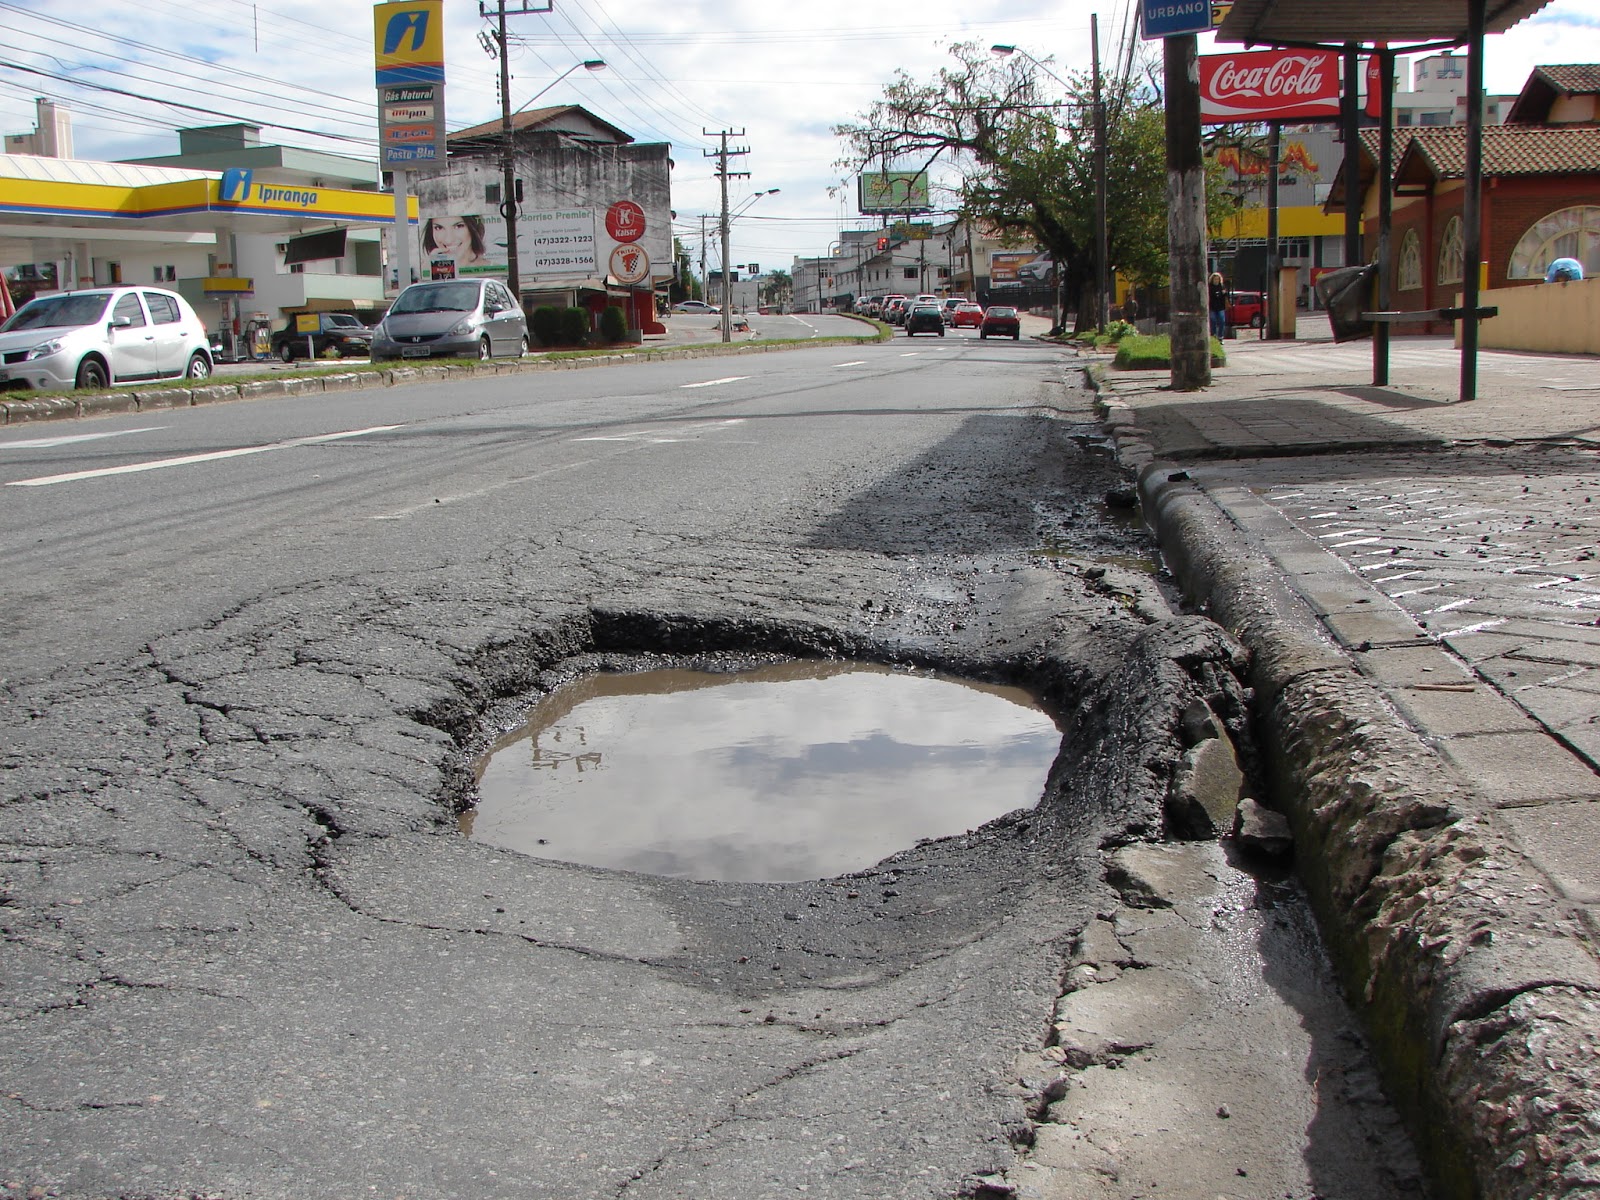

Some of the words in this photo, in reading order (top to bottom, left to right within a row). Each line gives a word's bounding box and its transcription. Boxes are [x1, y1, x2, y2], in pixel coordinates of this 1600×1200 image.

[1148, 2, 1204, 20] URBANO
[1209, 54, 1327, 100] Coca-Cola
[385, 92, 399, 102] Gás
[401, 89, 433, 100] Natural
[259, 184, 318, 207] Ipiranga
[521, 213, 553, 222] Sorriso
[556, 211, 591, 221] Premier
[615, 229, 638, 238] Kaiser
[534, 235, 593, 246] (47)3322-1223
[535, 256, 594, 268] (47)3328-1566
